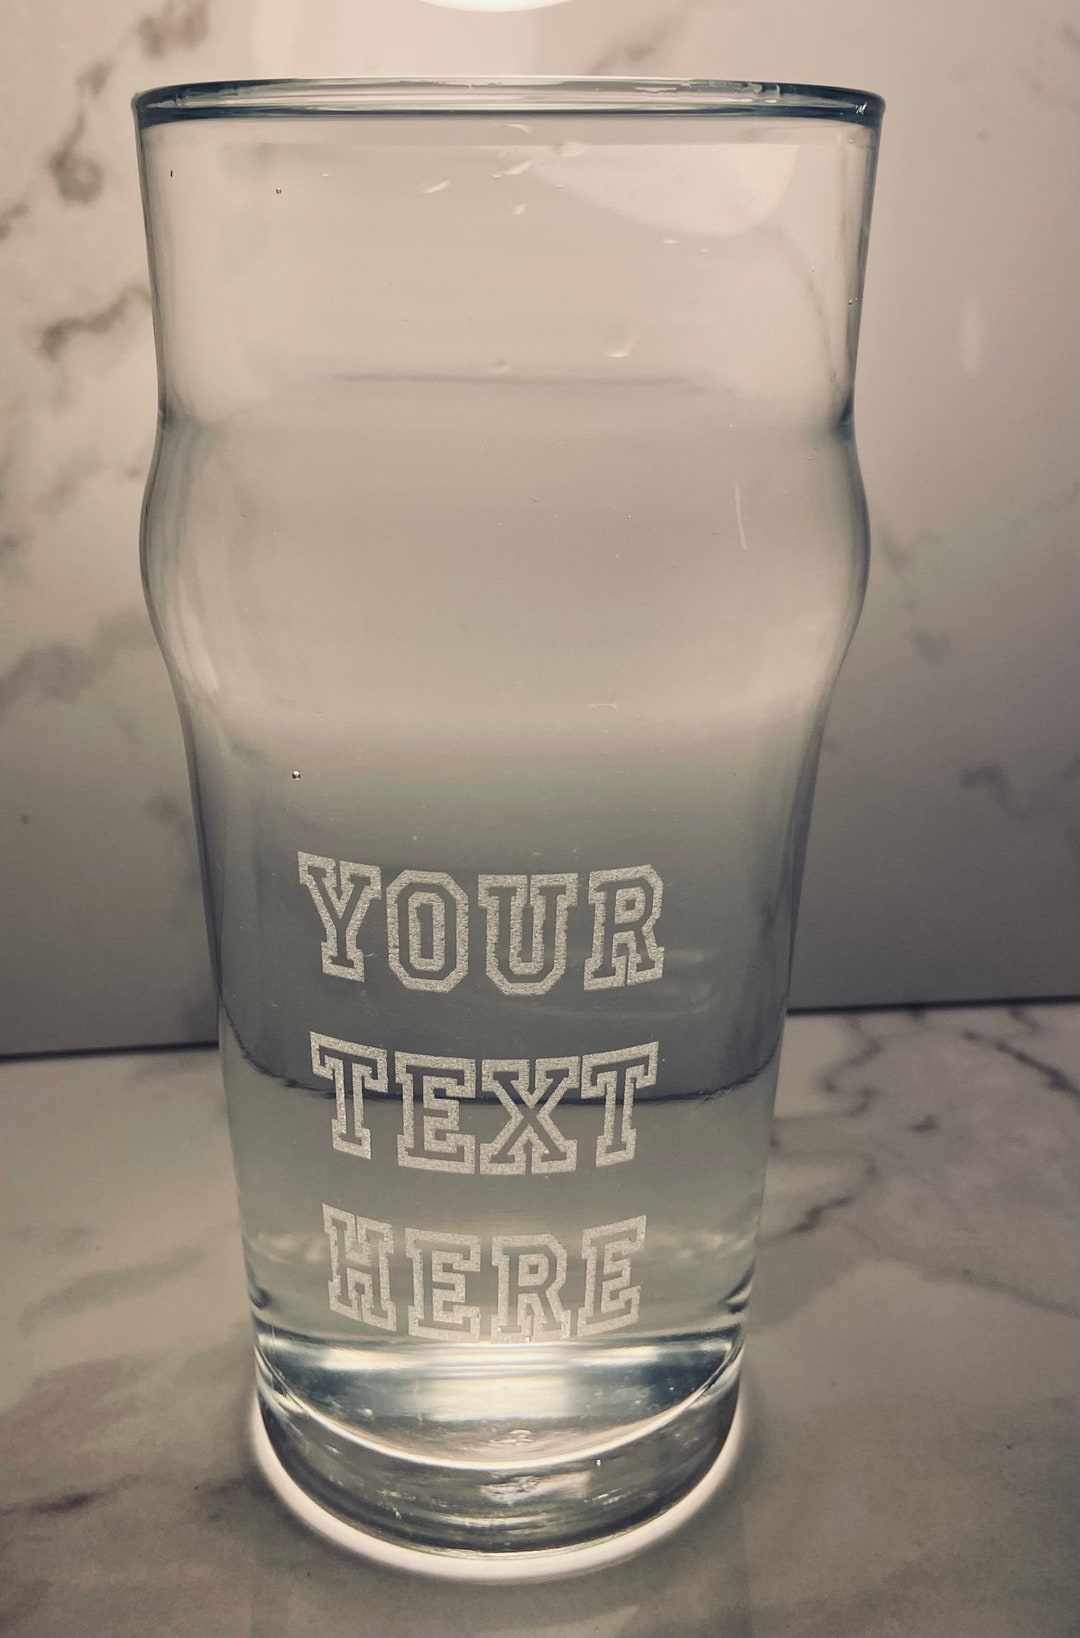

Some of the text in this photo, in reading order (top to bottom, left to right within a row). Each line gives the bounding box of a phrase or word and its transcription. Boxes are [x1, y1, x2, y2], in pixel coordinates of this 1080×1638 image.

[298, 851, 665, 995] YOUR
[310, 1031, 659, 1175] TEXT
[321, 1203, 647, 1343] HERE
